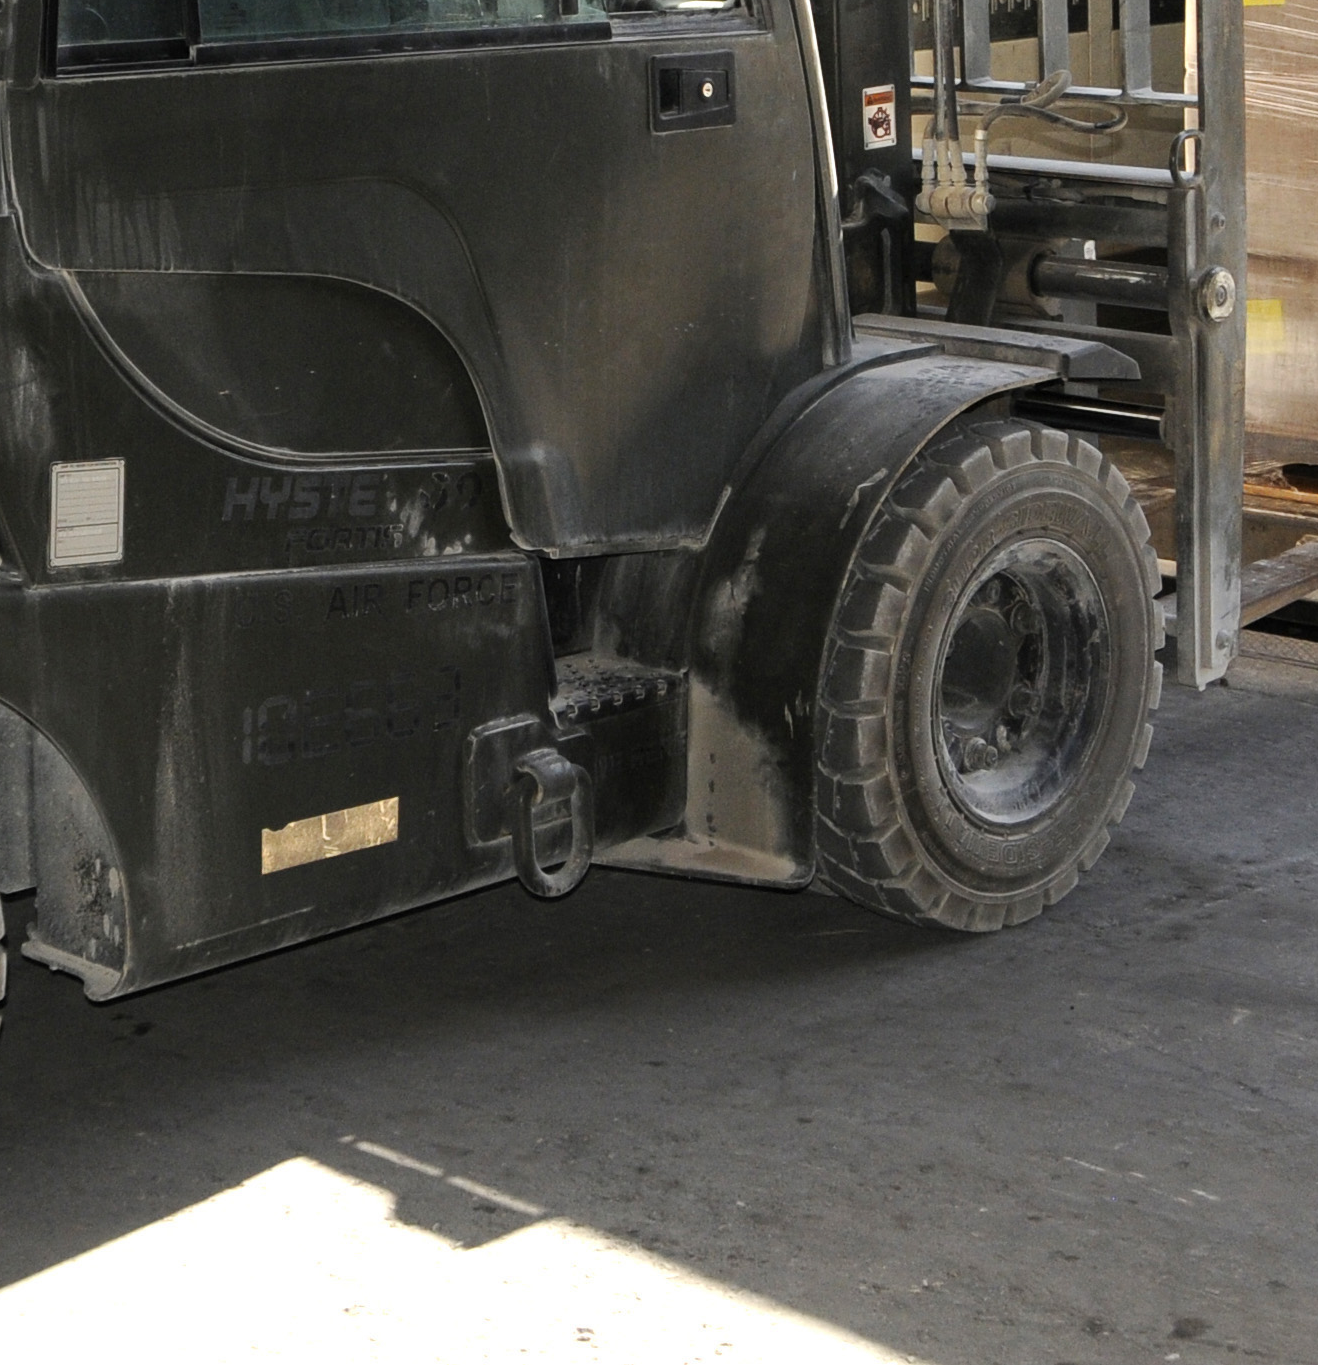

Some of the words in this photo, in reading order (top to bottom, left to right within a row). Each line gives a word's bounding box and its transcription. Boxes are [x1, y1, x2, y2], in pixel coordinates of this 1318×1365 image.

[221, 472, 410, 523] HYSTE
[325, 582, 389, 621] AIR
[405, 572, 520, 614] FORCE
